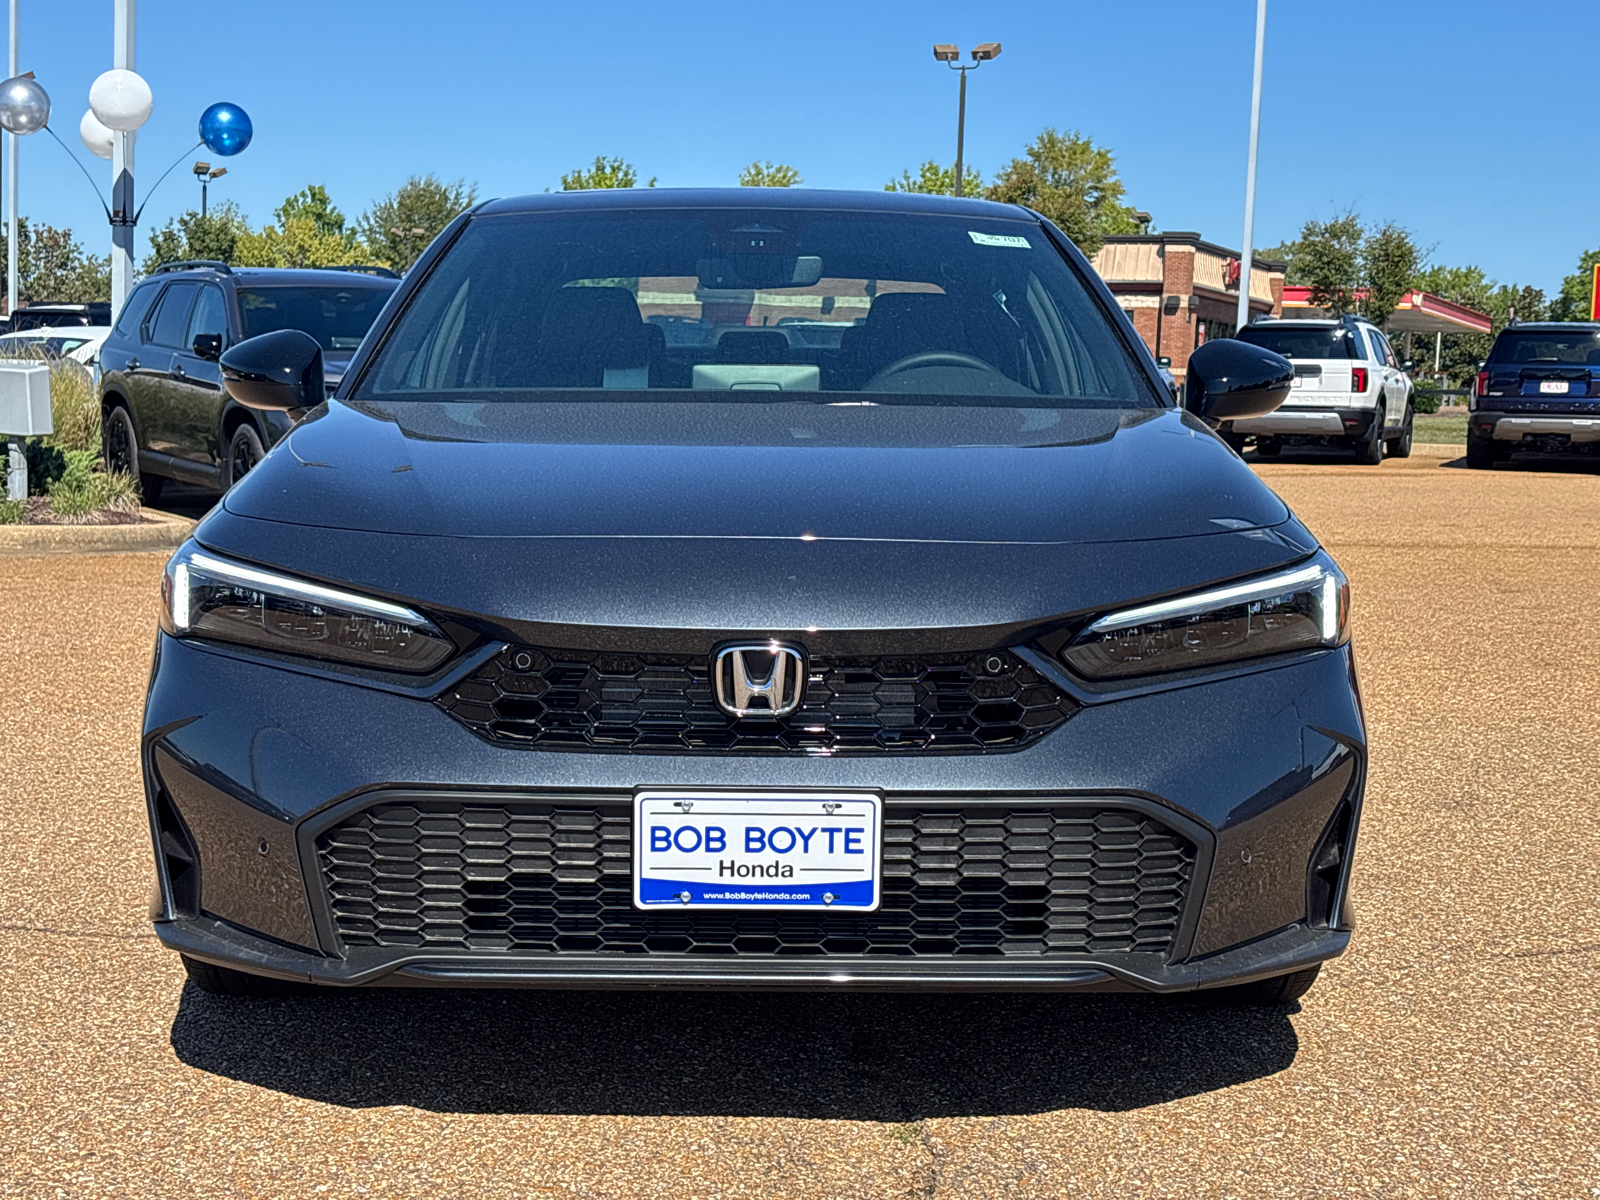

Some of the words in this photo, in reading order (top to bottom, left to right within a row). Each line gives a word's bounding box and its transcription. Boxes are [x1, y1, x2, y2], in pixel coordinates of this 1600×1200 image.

[650, 825, 727, 853] BOB
[745, 826, 865, 854] BOYTE
[718, 860, 794, 878] Honda
[703, 891, 810, 902] www.BobBoyteHonda.com
